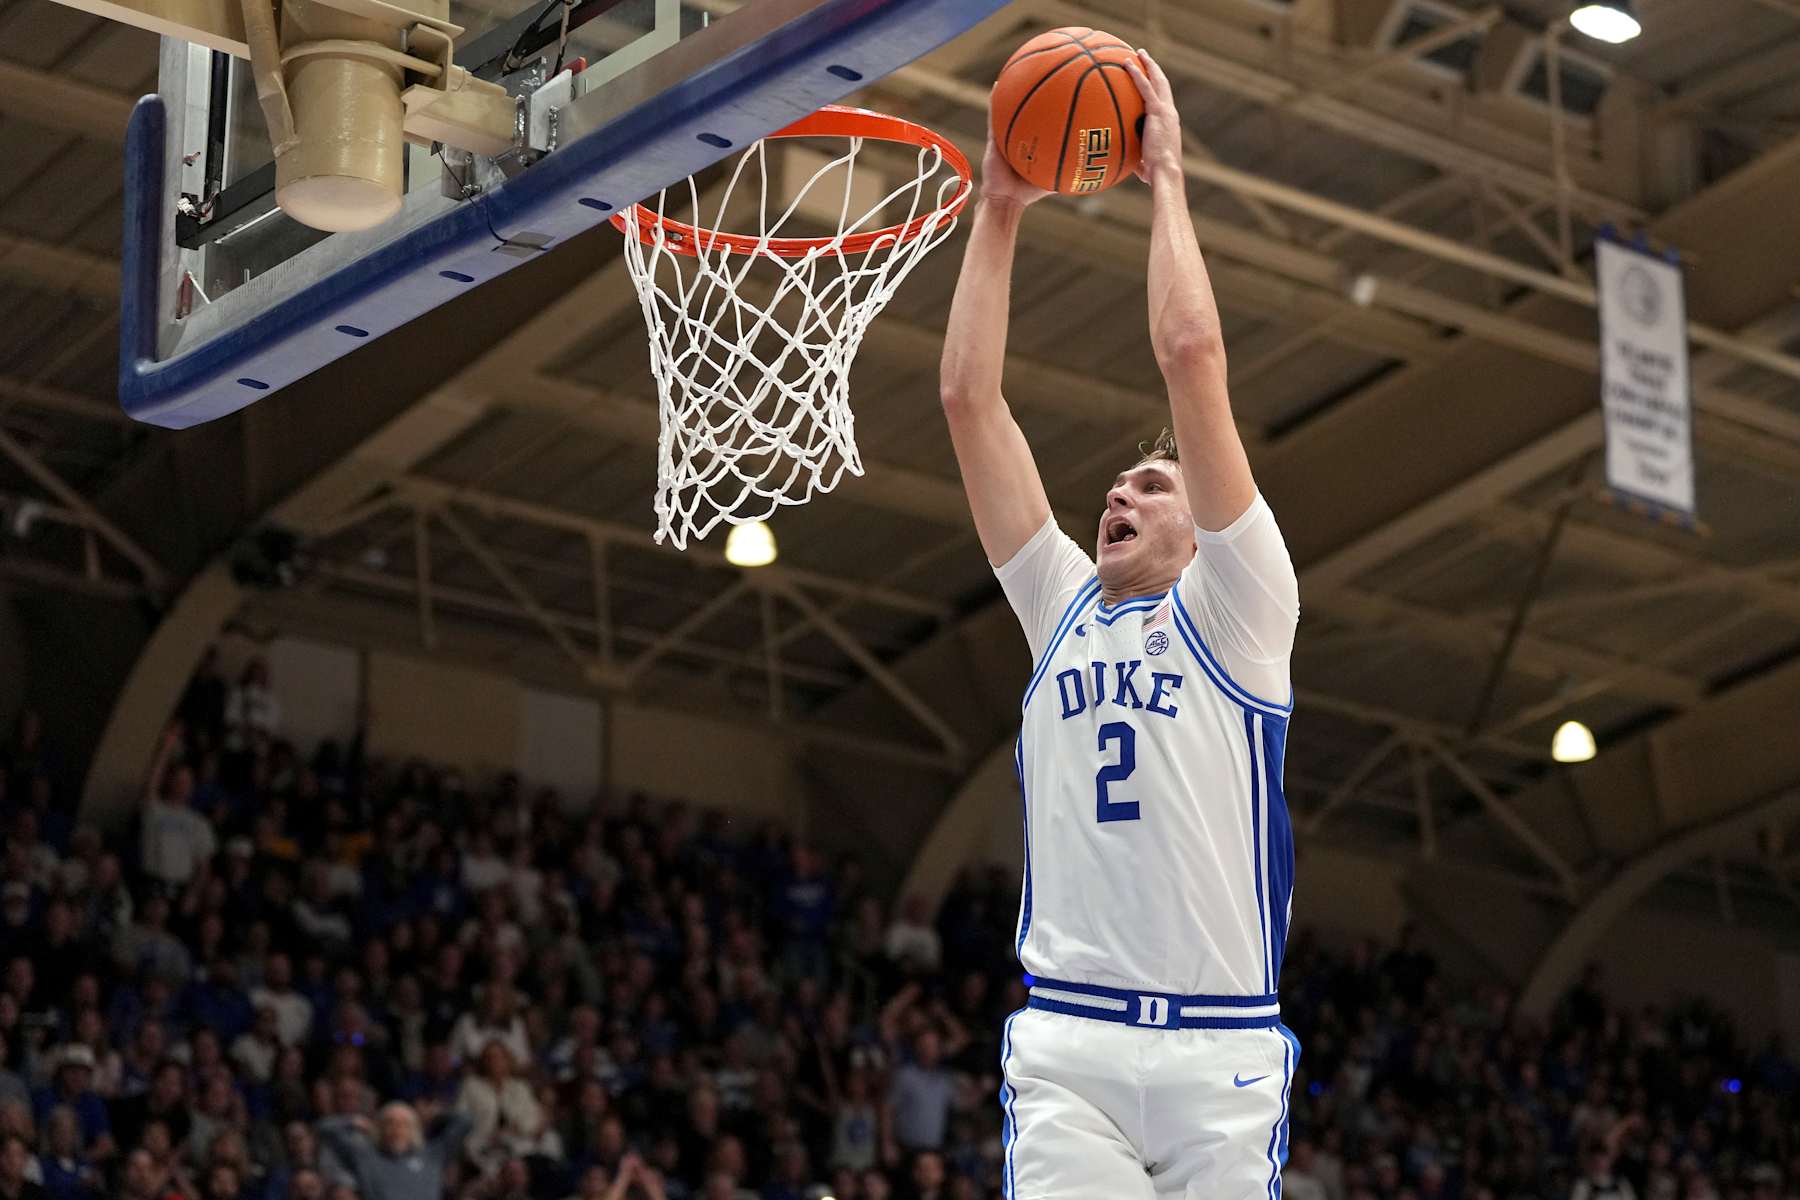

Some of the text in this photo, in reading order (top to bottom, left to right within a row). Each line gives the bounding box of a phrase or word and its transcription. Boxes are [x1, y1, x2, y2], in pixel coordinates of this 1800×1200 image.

[1070, 129, 1086, 192] CHAMPION
[1079, 128, 1111, 192] ELITE
[1096, 721, 1141, 823] 2
